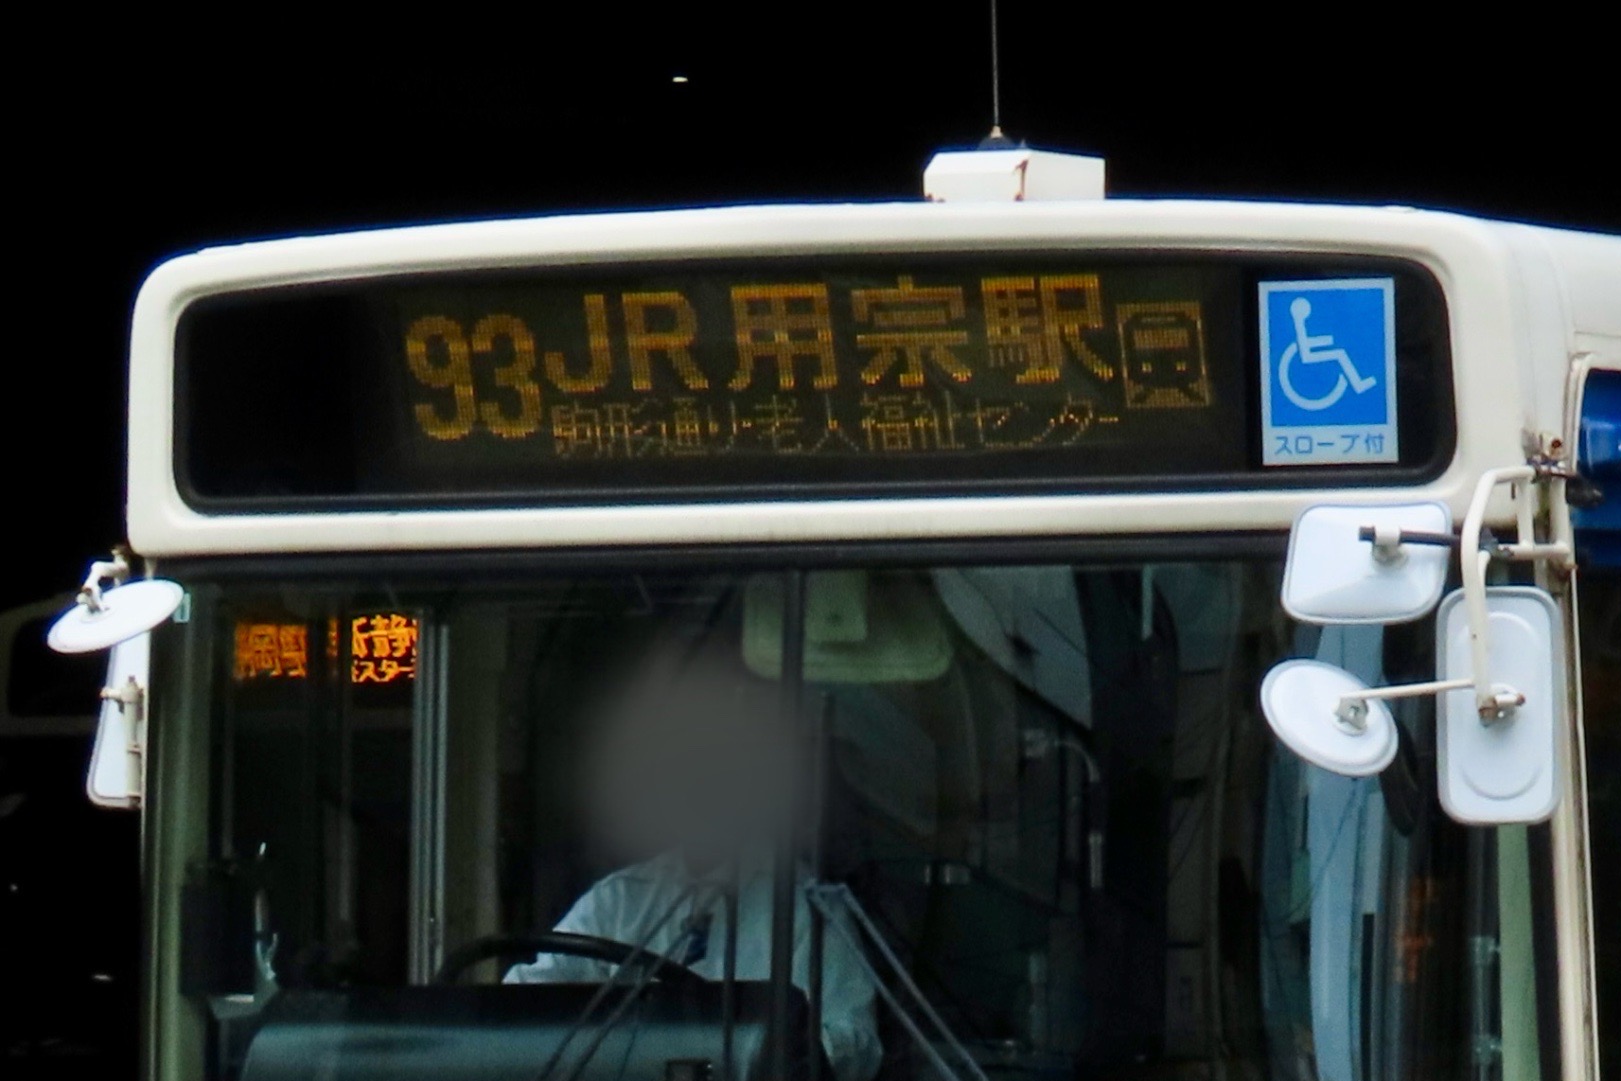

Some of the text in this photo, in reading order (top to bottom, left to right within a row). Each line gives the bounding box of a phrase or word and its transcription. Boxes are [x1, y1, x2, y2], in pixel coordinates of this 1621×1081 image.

[407, 274, 1114, 441] 93 JR用宗駅
[1274, 433, 1385, 455] スロープ付
